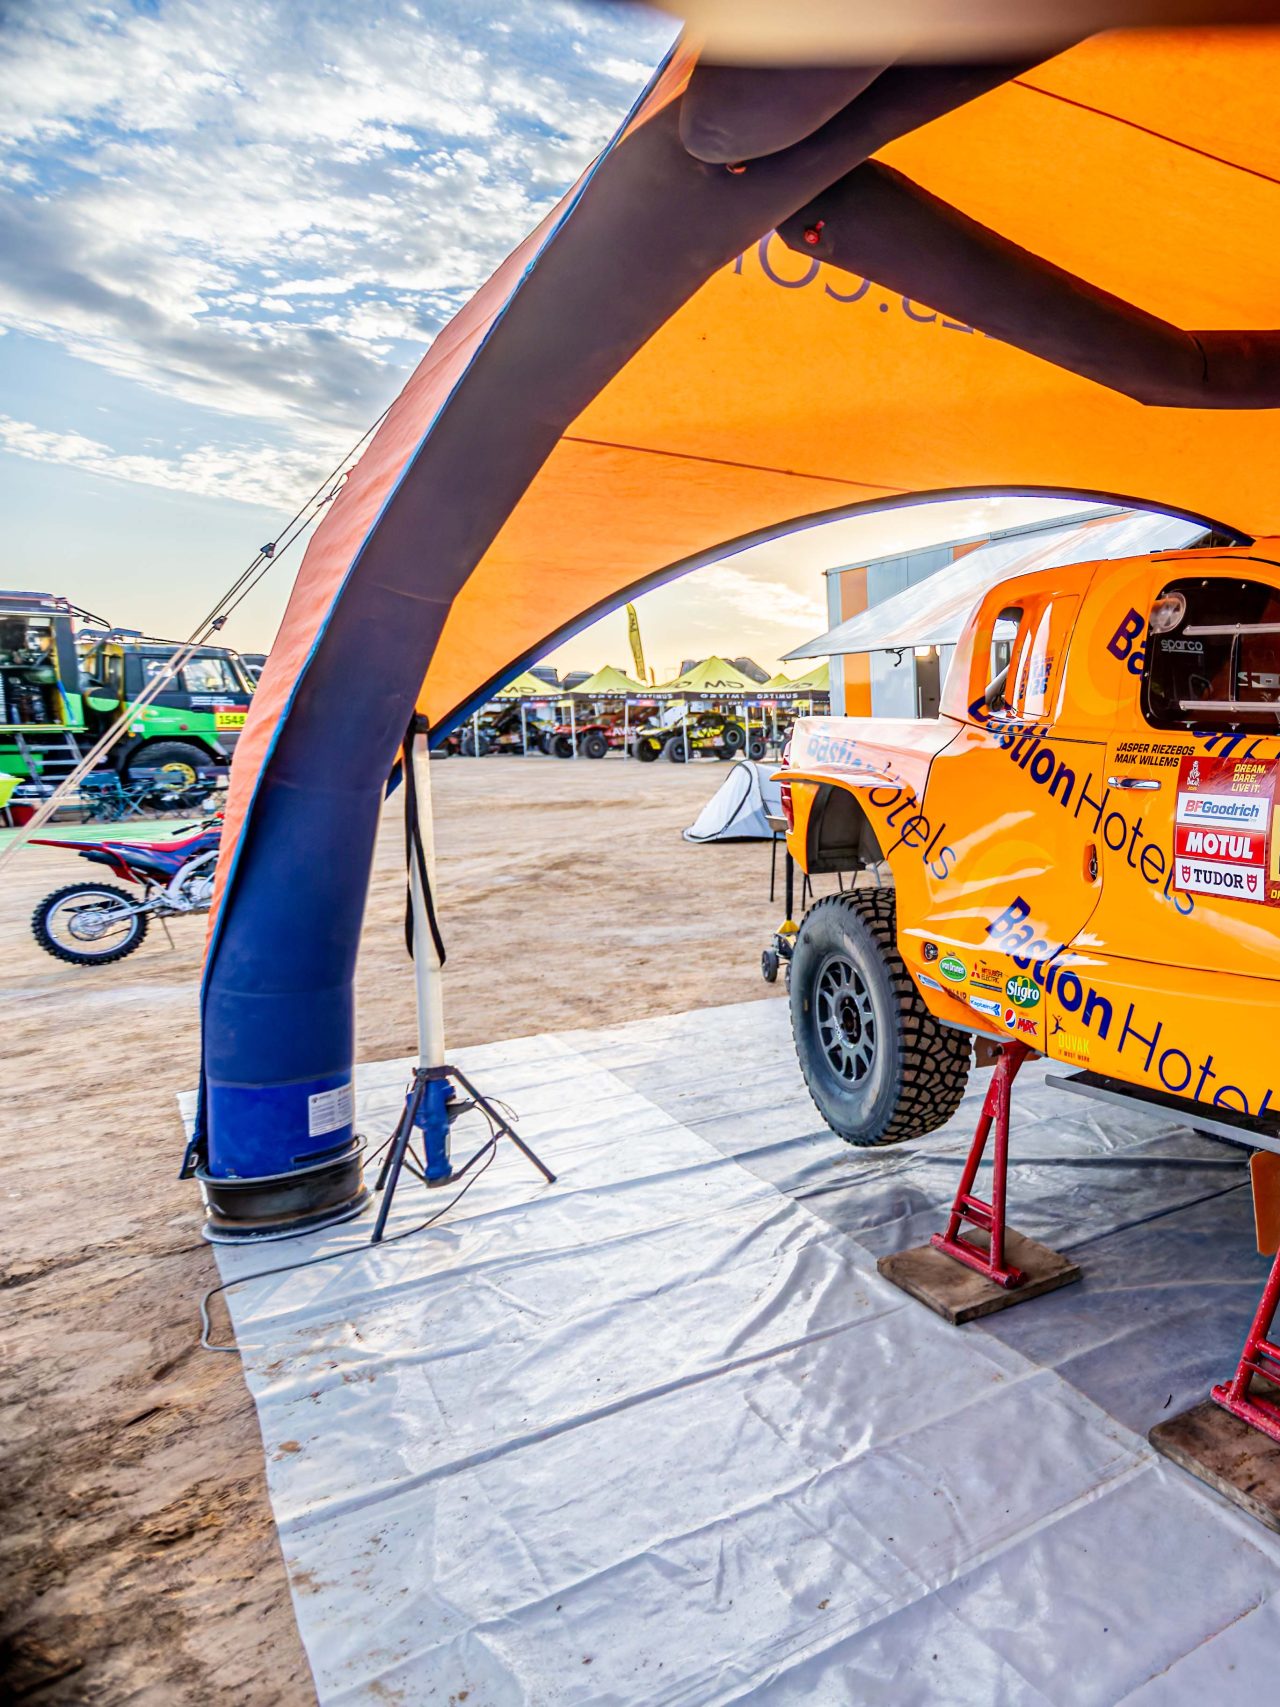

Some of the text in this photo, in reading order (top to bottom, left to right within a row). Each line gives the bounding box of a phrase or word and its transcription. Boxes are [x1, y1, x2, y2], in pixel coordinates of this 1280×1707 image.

[1161, 639, 1203, 653] sparco
[1116, 742, 1195, 756] JASPER RIEZEBOS
[1114, 753, 1180, 767] MAIK WILLEMS
[1234, 763, 1267, 774] DREAM.
[1232, 773, 1257, 783] DARE.
[1231, 783, 1249, 792] LIVE
[1184, 799, 1259, 818] BFGoodrich
[859, 762, 956, 880] otels
[1185, 831, 1254, 860] MOTUL
[1193, 868, 1244, 889] TUDOR
[985, 895, 1113, 1040] Bastion
[1006, 980, 1040, 1003] Sligro
